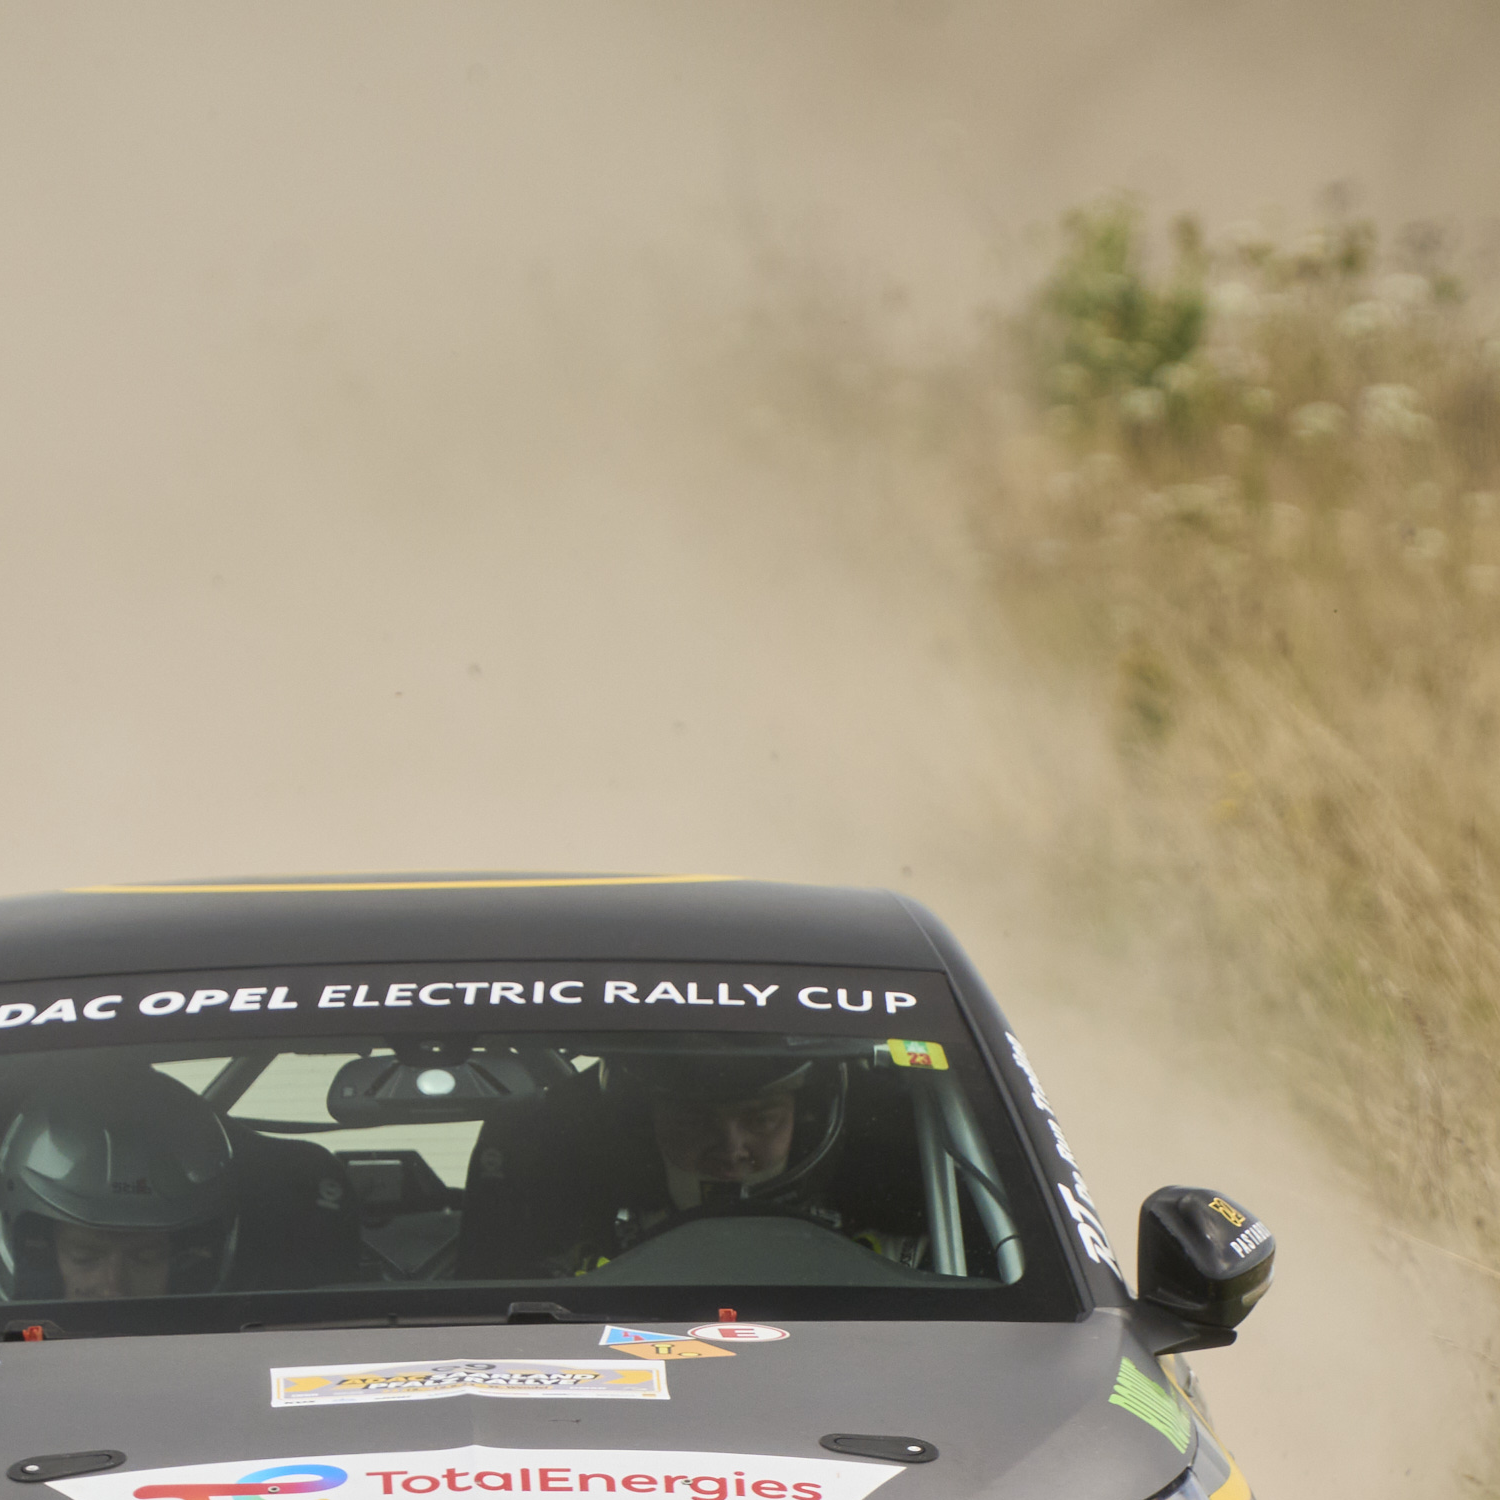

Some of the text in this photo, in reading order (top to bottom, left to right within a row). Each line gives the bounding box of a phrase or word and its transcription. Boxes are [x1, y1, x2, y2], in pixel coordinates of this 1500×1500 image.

[138, 986, 299, 1016] OPEL
[317, 981, 585, 1009] ELECTRIC
[603, 980, 781, 1007] RALLY
[797, 986, 918, 1014] CUP
[428, 1371, 600, 1382] SAARLAND
[463, 1376, 578, 1385] RALLYE
